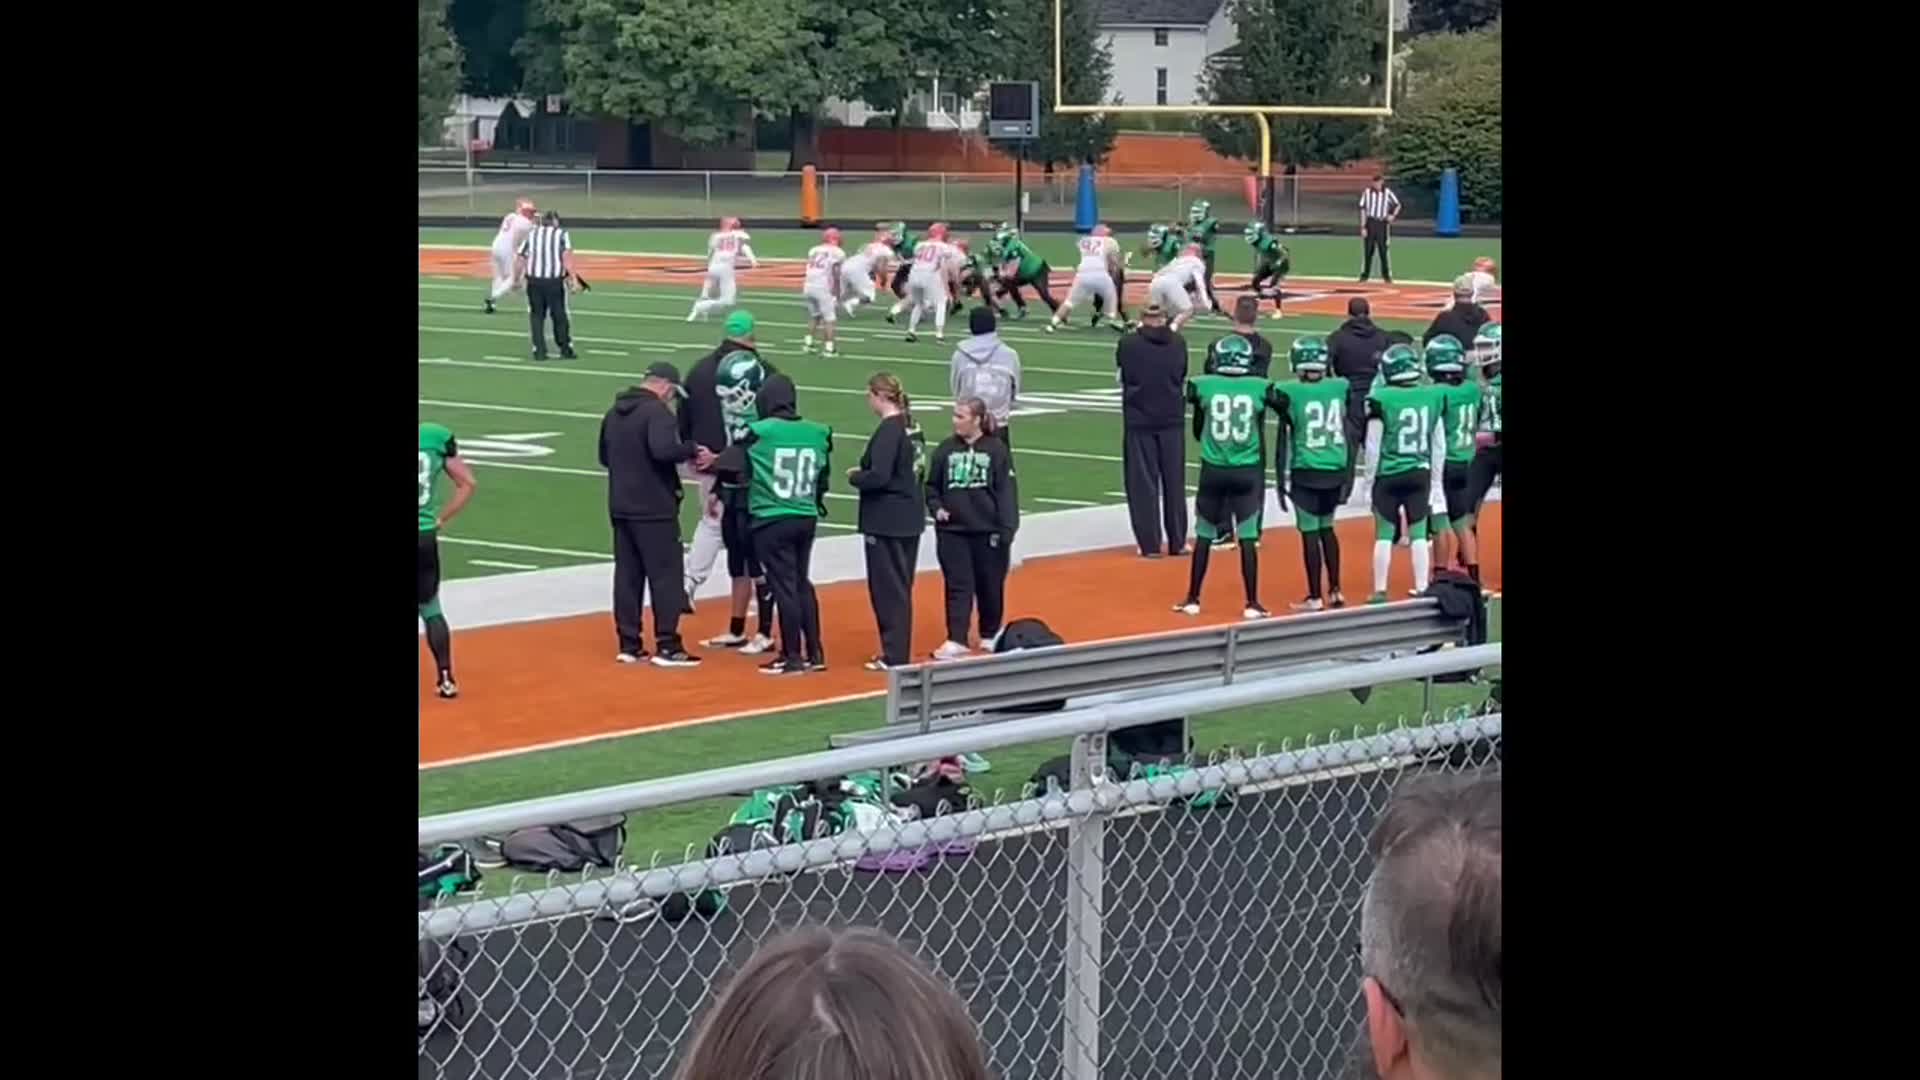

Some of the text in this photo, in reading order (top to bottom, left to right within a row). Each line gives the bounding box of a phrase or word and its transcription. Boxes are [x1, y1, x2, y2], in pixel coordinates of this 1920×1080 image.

[1211, 393, 1253, 442] 83
[1305, 398, 1348, 449] 24
[1397, 405, 1430, 454] 21
[1456, 403, 1475, 450] 11
[772, 447, 817, 500] 50
